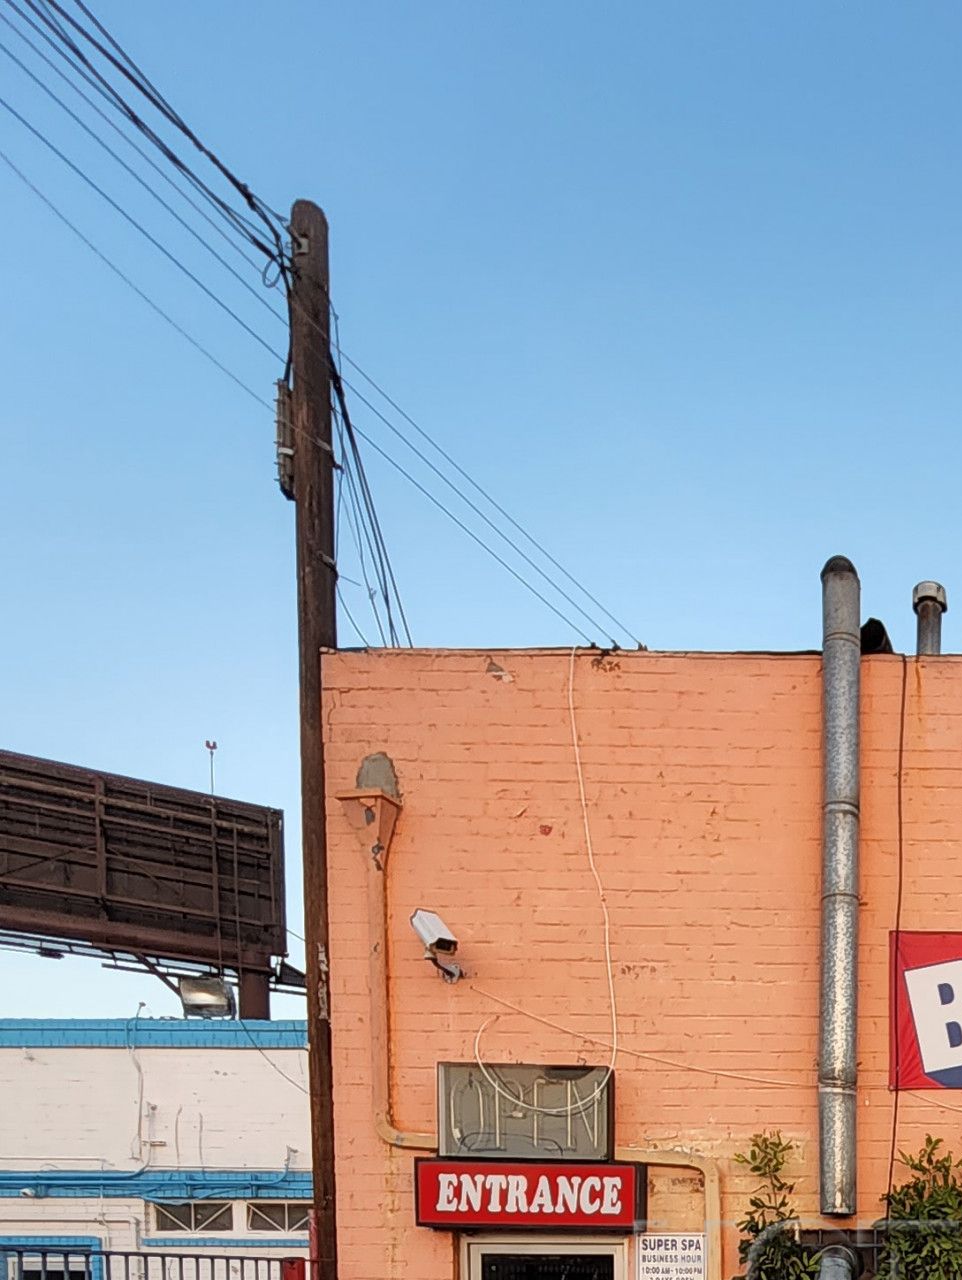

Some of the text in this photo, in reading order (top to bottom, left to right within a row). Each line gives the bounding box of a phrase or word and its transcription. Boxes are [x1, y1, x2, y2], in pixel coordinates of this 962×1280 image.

[435, 1172, 623, 1216] ENTRANCE
[642, 1238, 702, 1251] SUPER SPA
[642, 1254, 679, 1263] BUSINESS
